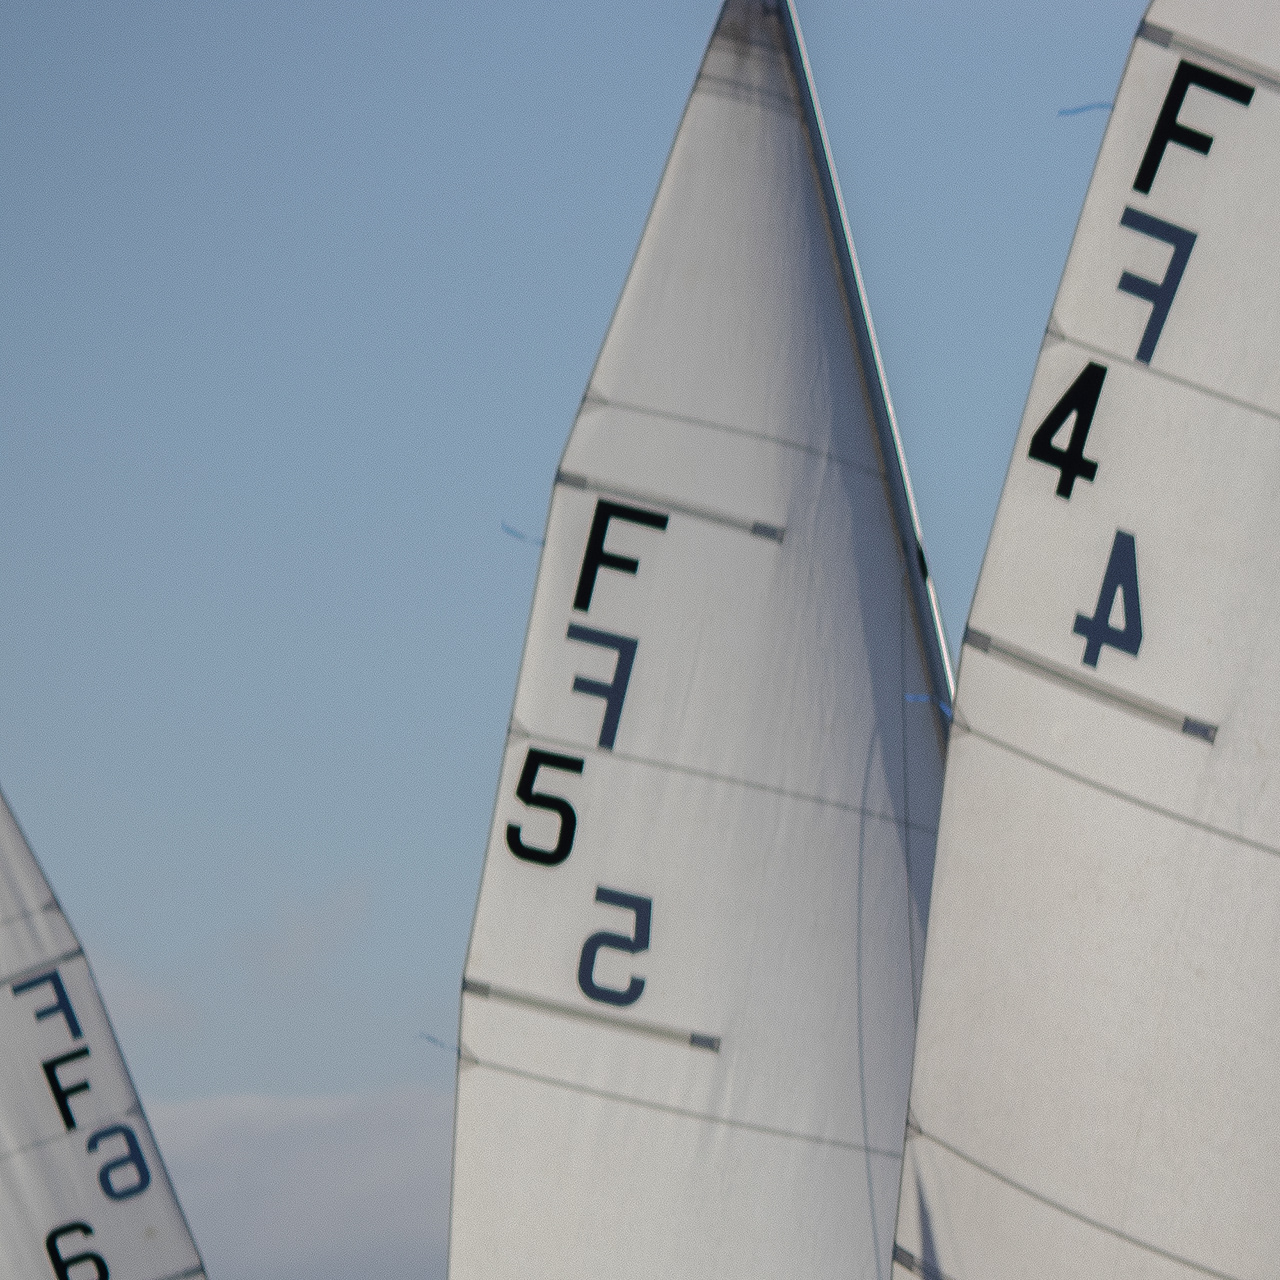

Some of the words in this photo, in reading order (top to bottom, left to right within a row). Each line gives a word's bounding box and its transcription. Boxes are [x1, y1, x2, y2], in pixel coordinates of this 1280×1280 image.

[1133, 60, 1255, 194] F
[1029, 362, 1107, 499] 4
[574, 499, 668, 612] F
[507, 748, 584, 866] 5
[42, 1047, 89, 1131] F
